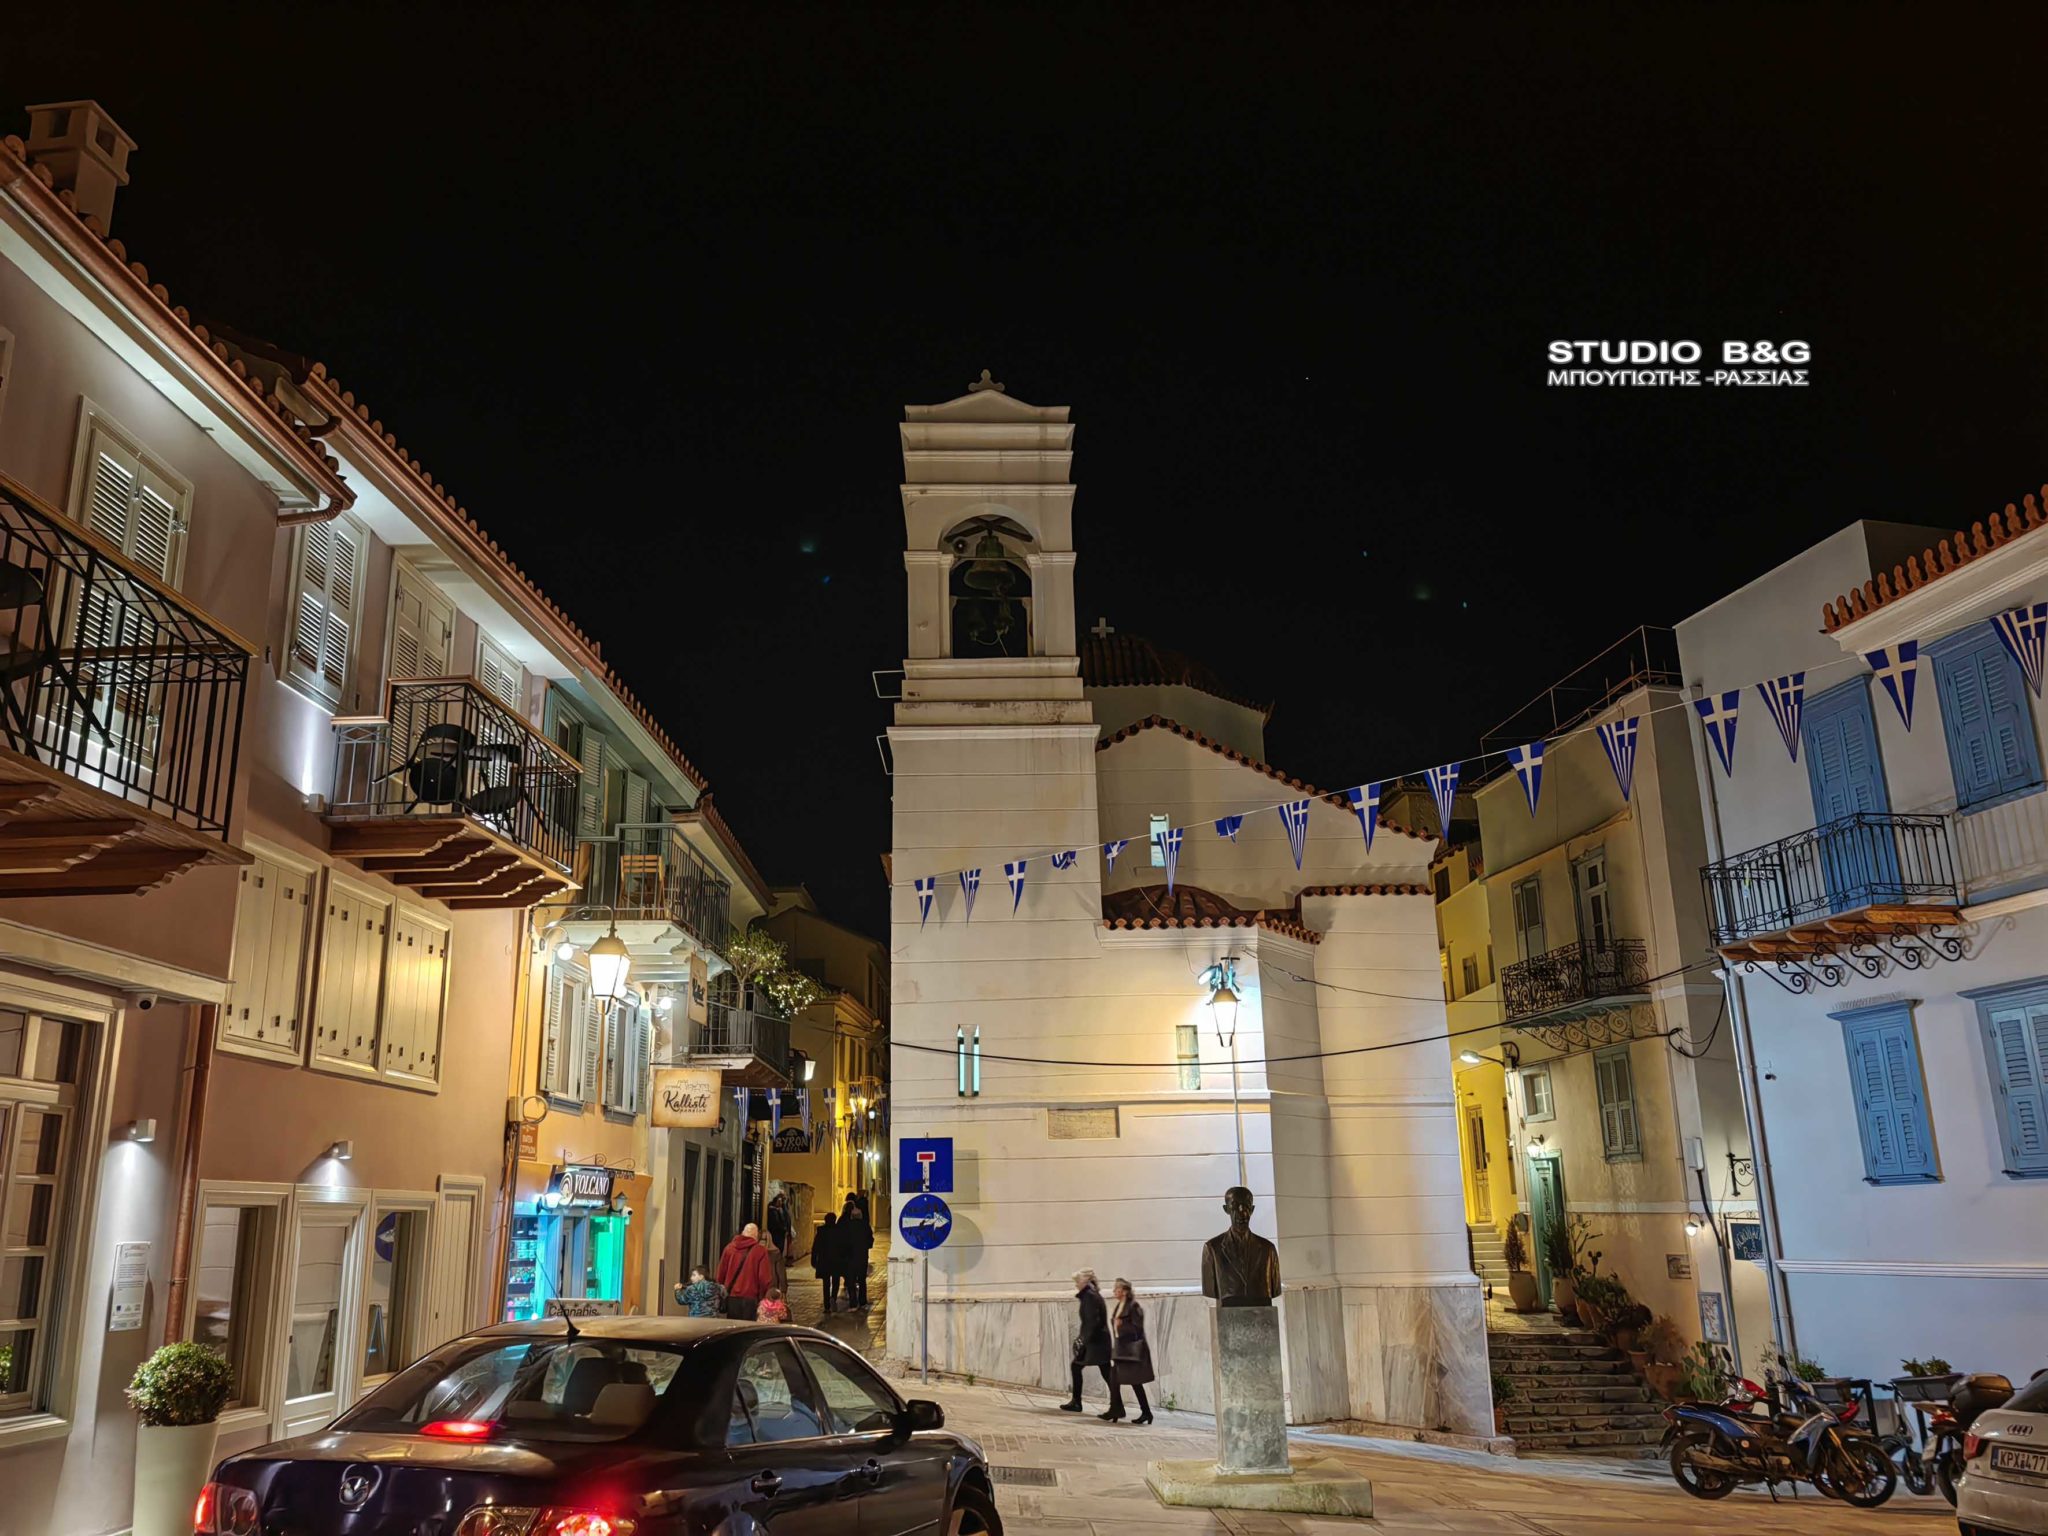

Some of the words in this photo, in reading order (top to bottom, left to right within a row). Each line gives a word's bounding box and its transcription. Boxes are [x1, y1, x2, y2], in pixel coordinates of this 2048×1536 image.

[663, 1090, 710, 1112] Kallisti
[775, 1136, 809, 1148] BYRON
[574, 1174, 610, 1196] VOLCANO
